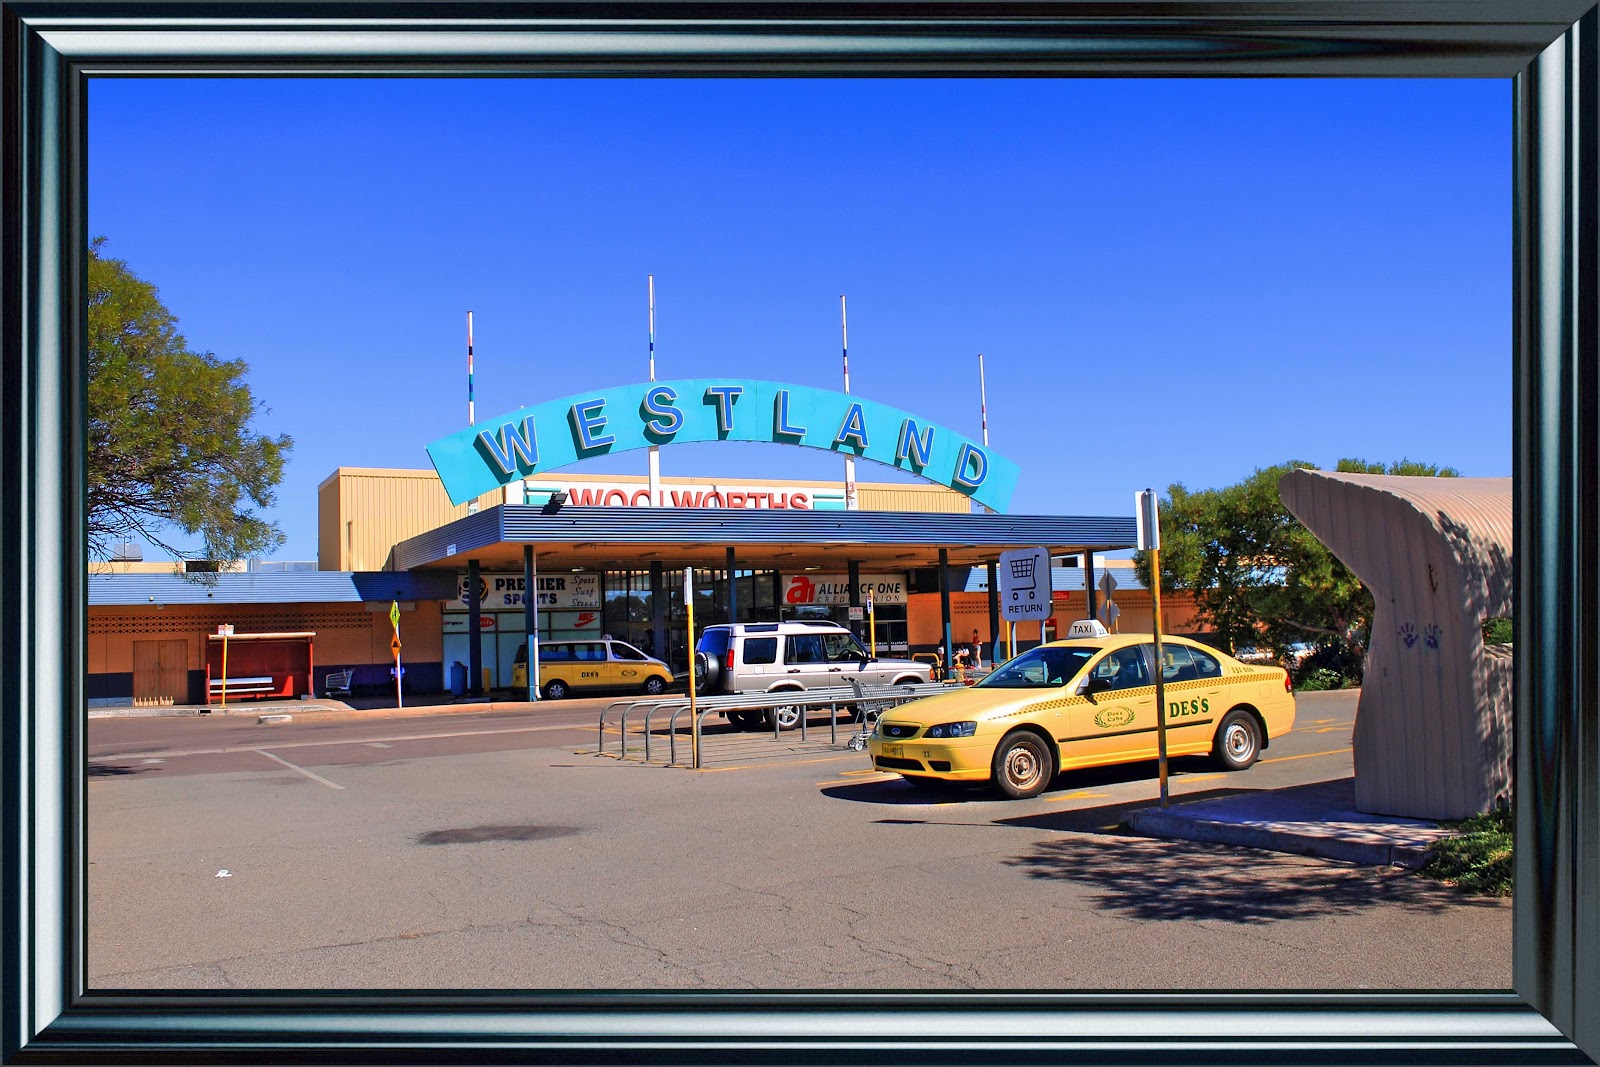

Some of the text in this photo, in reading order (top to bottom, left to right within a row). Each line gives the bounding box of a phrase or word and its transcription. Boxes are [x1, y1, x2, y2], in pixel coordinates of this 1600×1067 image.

[478, 384, 989, 489] WESTLAND
[495, 577, 566, 591] PREIER
[570, 575, 596, 586] Sport
[572, 587, 596, 597] Surf
[818, 582, 901, 595] ALLIACE ONE
[503, 593, 558, 605] SPTS
[569, 599, 598, 607] Street
[1008, 603, 1043, 614] RETURN
[577, 612, 595, 621] NIKE
[1072, 625, 1092, 634] TAXI
[581, 670, 599, 678] DES'S
[1169, 695, 1210, 718] DES'S
